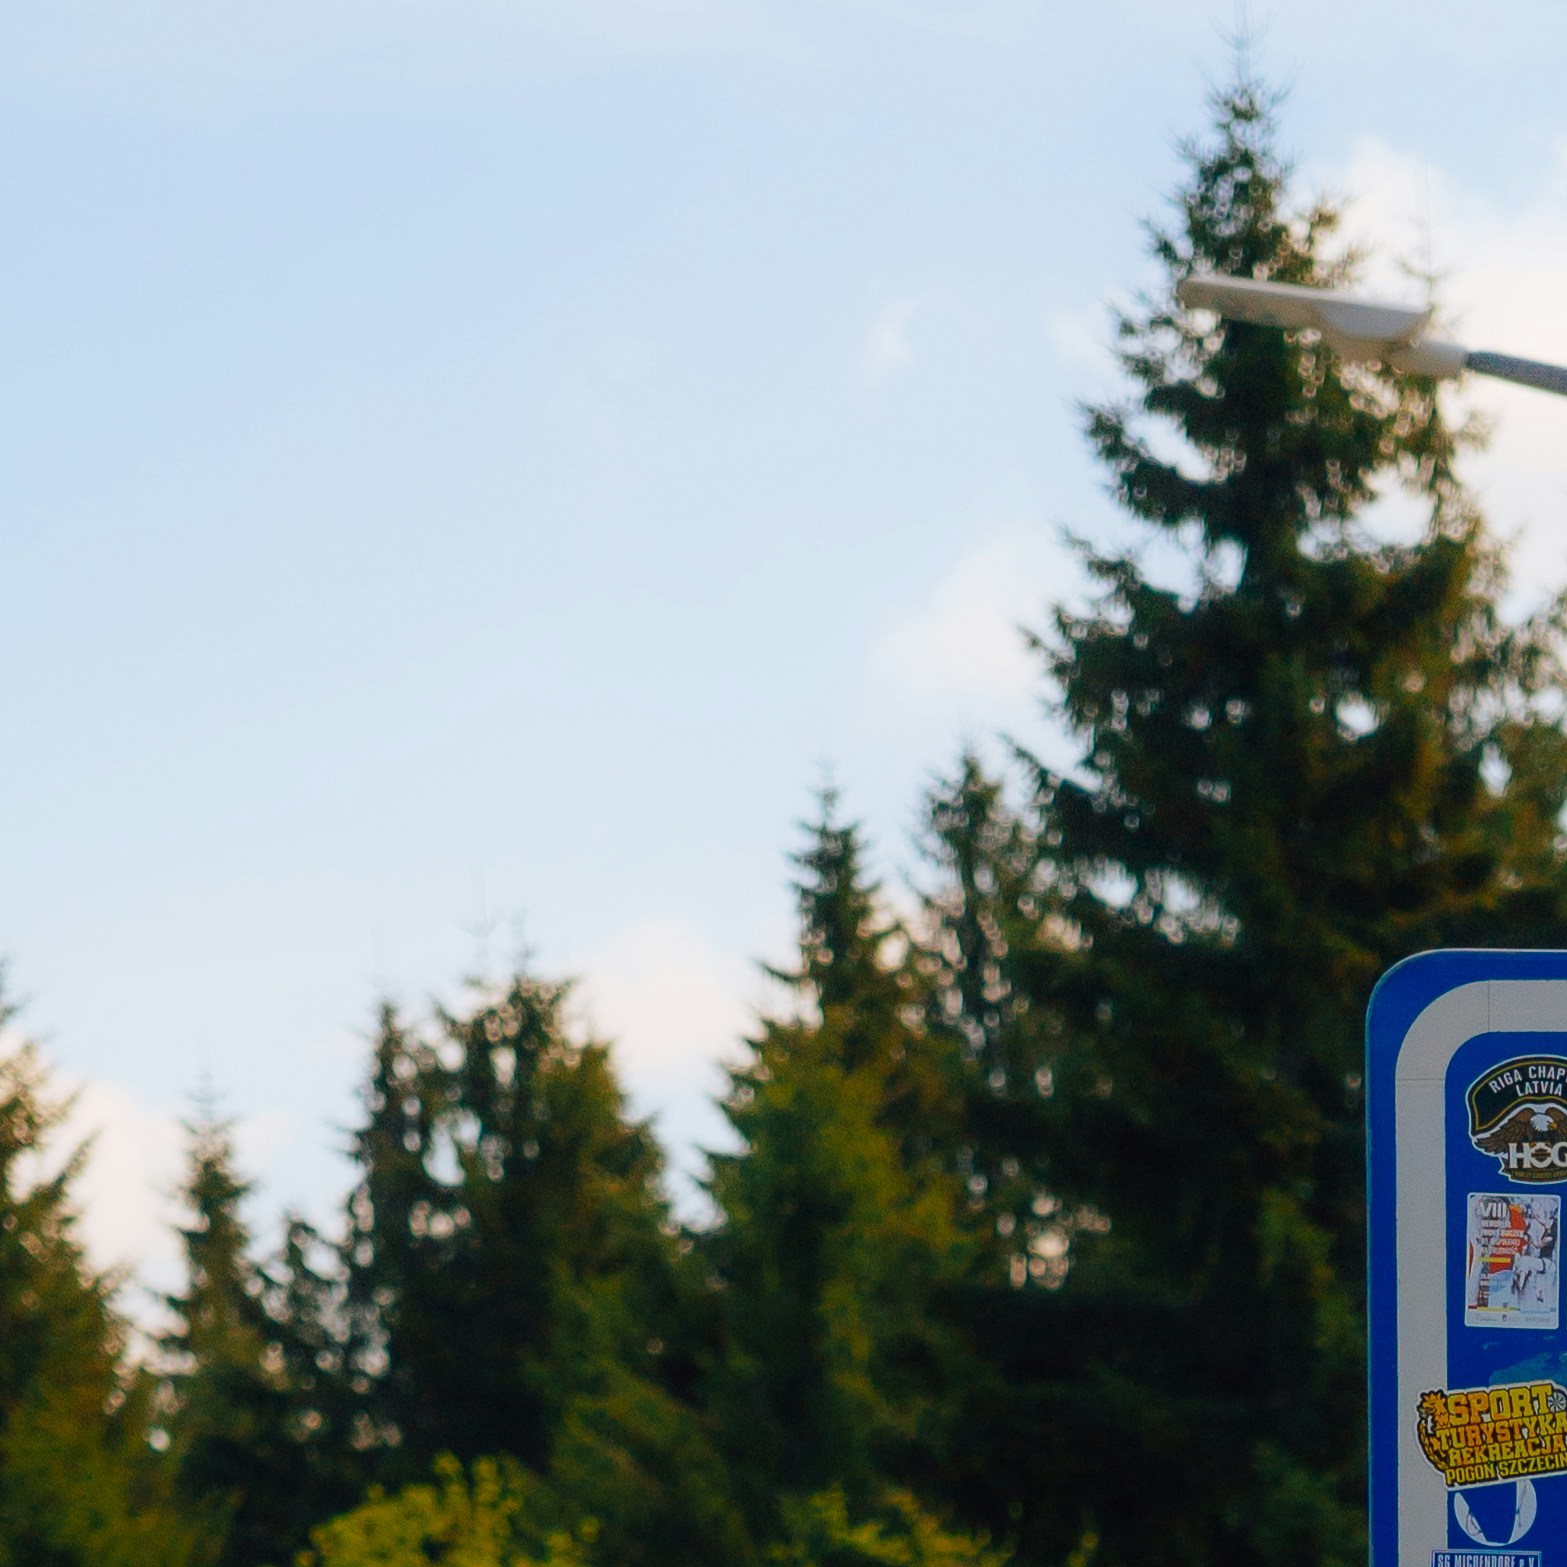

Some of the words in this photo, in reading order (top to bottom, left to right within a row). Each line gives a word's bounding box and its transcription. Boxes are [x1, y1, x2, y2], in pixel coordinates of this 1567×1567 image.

[1489, 1067, 1523, 1094] RIGA
[1516, 1080, 1563, 1097] LATVIA
[1448, 1384, 1552, 1425] SPORT
[1449, 1436, 1567, 1467] REKREACJA
